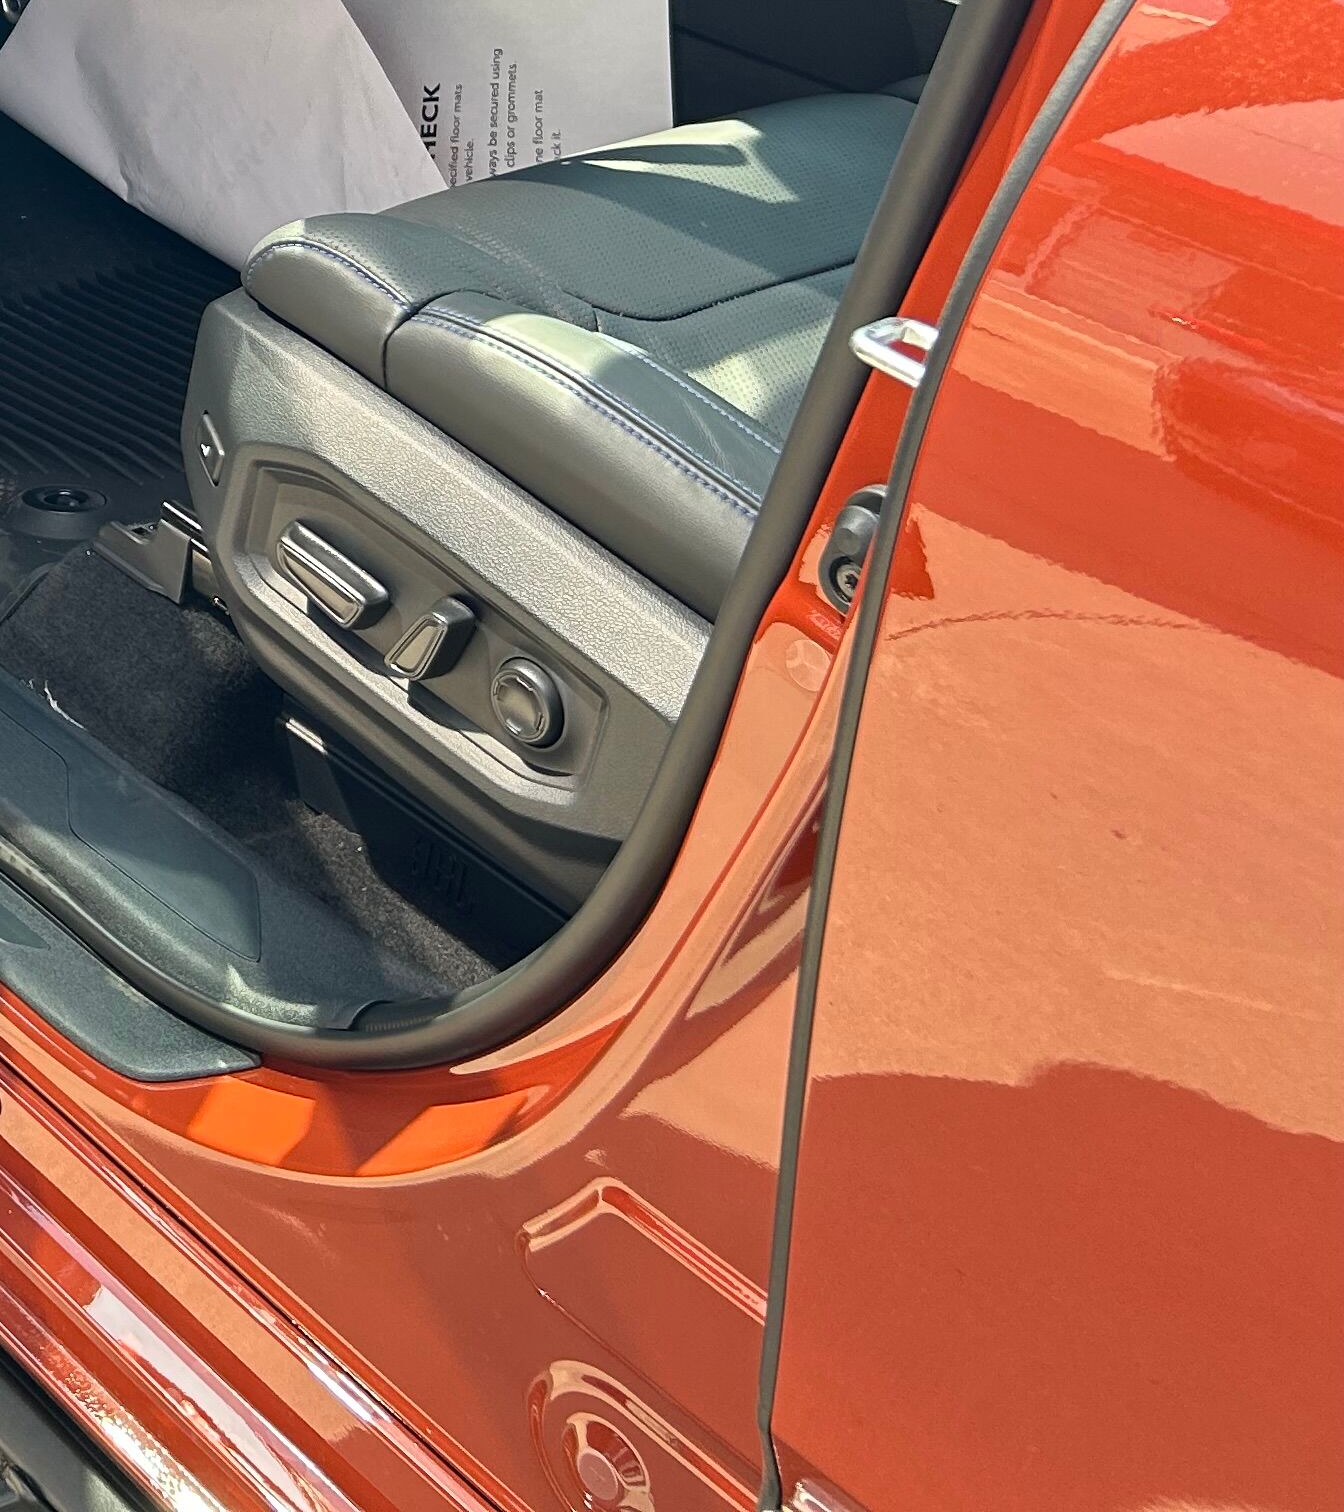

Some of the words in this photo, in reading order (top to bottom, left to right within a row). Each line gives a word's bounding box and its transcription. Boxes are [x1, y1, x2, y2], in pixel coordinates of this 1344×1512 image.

[491, 48, 503, 80] using
[453, 83, 462, 113] mats
[489, 83, 499, 128] secured
[534, 90, 543, 113] mat
[420, 83, 441, 160] HECK
[449, 116, 460, 143] floor
[507, 125, 516, 139] or
[533, 117, 543, 145] floor
[488, 131, 498, 147] be
[504, 141, 517, 168] clips
